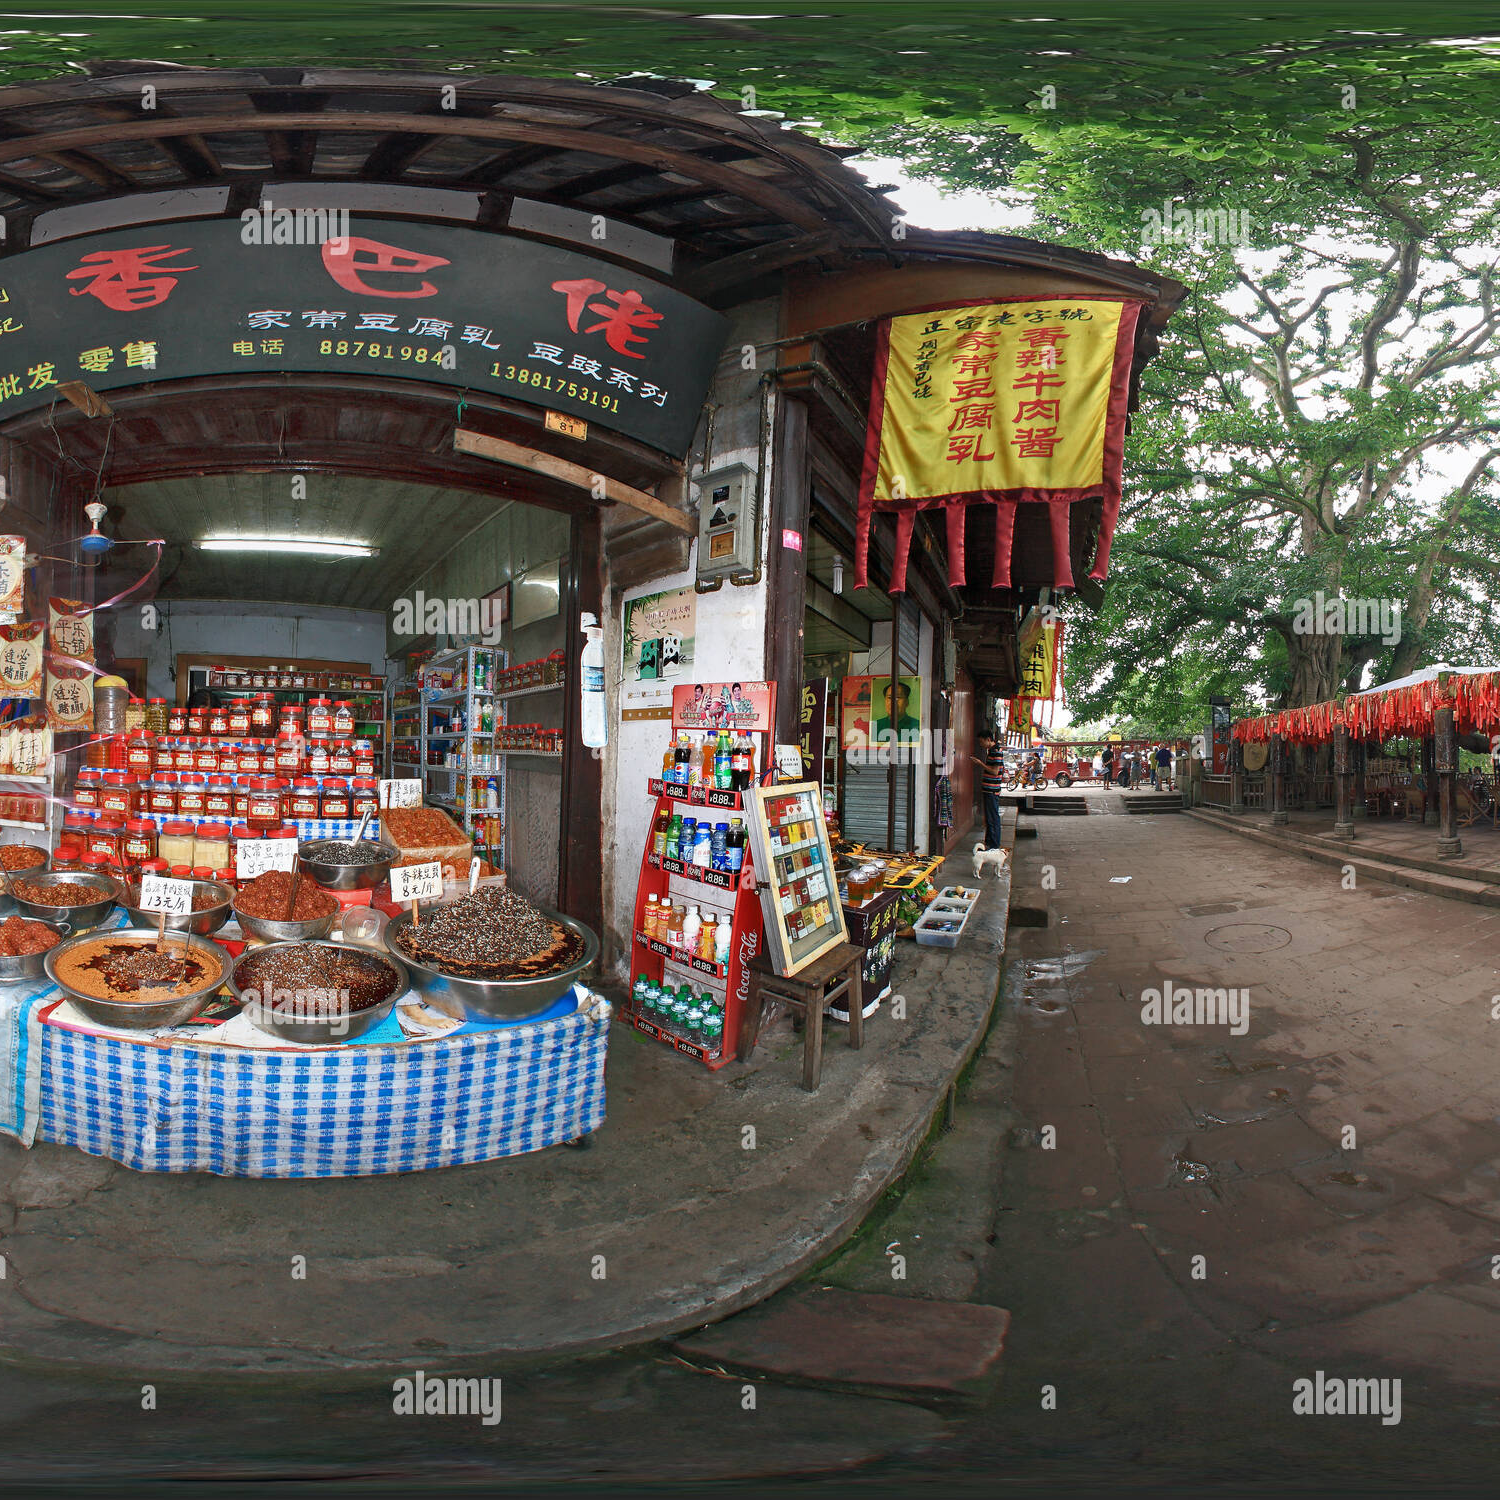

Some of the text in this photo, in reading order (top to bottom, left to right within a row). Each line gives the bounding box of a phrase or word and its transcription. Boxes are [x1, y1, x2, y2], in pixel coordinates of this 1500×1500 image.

[66, 236, 664, 359] 香巴佬
[920, 307, 1094, 336] 正宗老字號
[79, 341, 158, 372] 零售
[233, 339, 619, 414] 电话 88781984 13881753191
[248, 310, 668, 407] 家常豆腐乳 豆豉系列
[946, 329, 1002, 465] 家常豆腐乳
[560, 422, 574, 433] 81
[147, 896, 186, 912] 13元/斤
[403, 881, 434, 898] 8元/斤
[736, 928, 758, 1000] Coca-Cola
